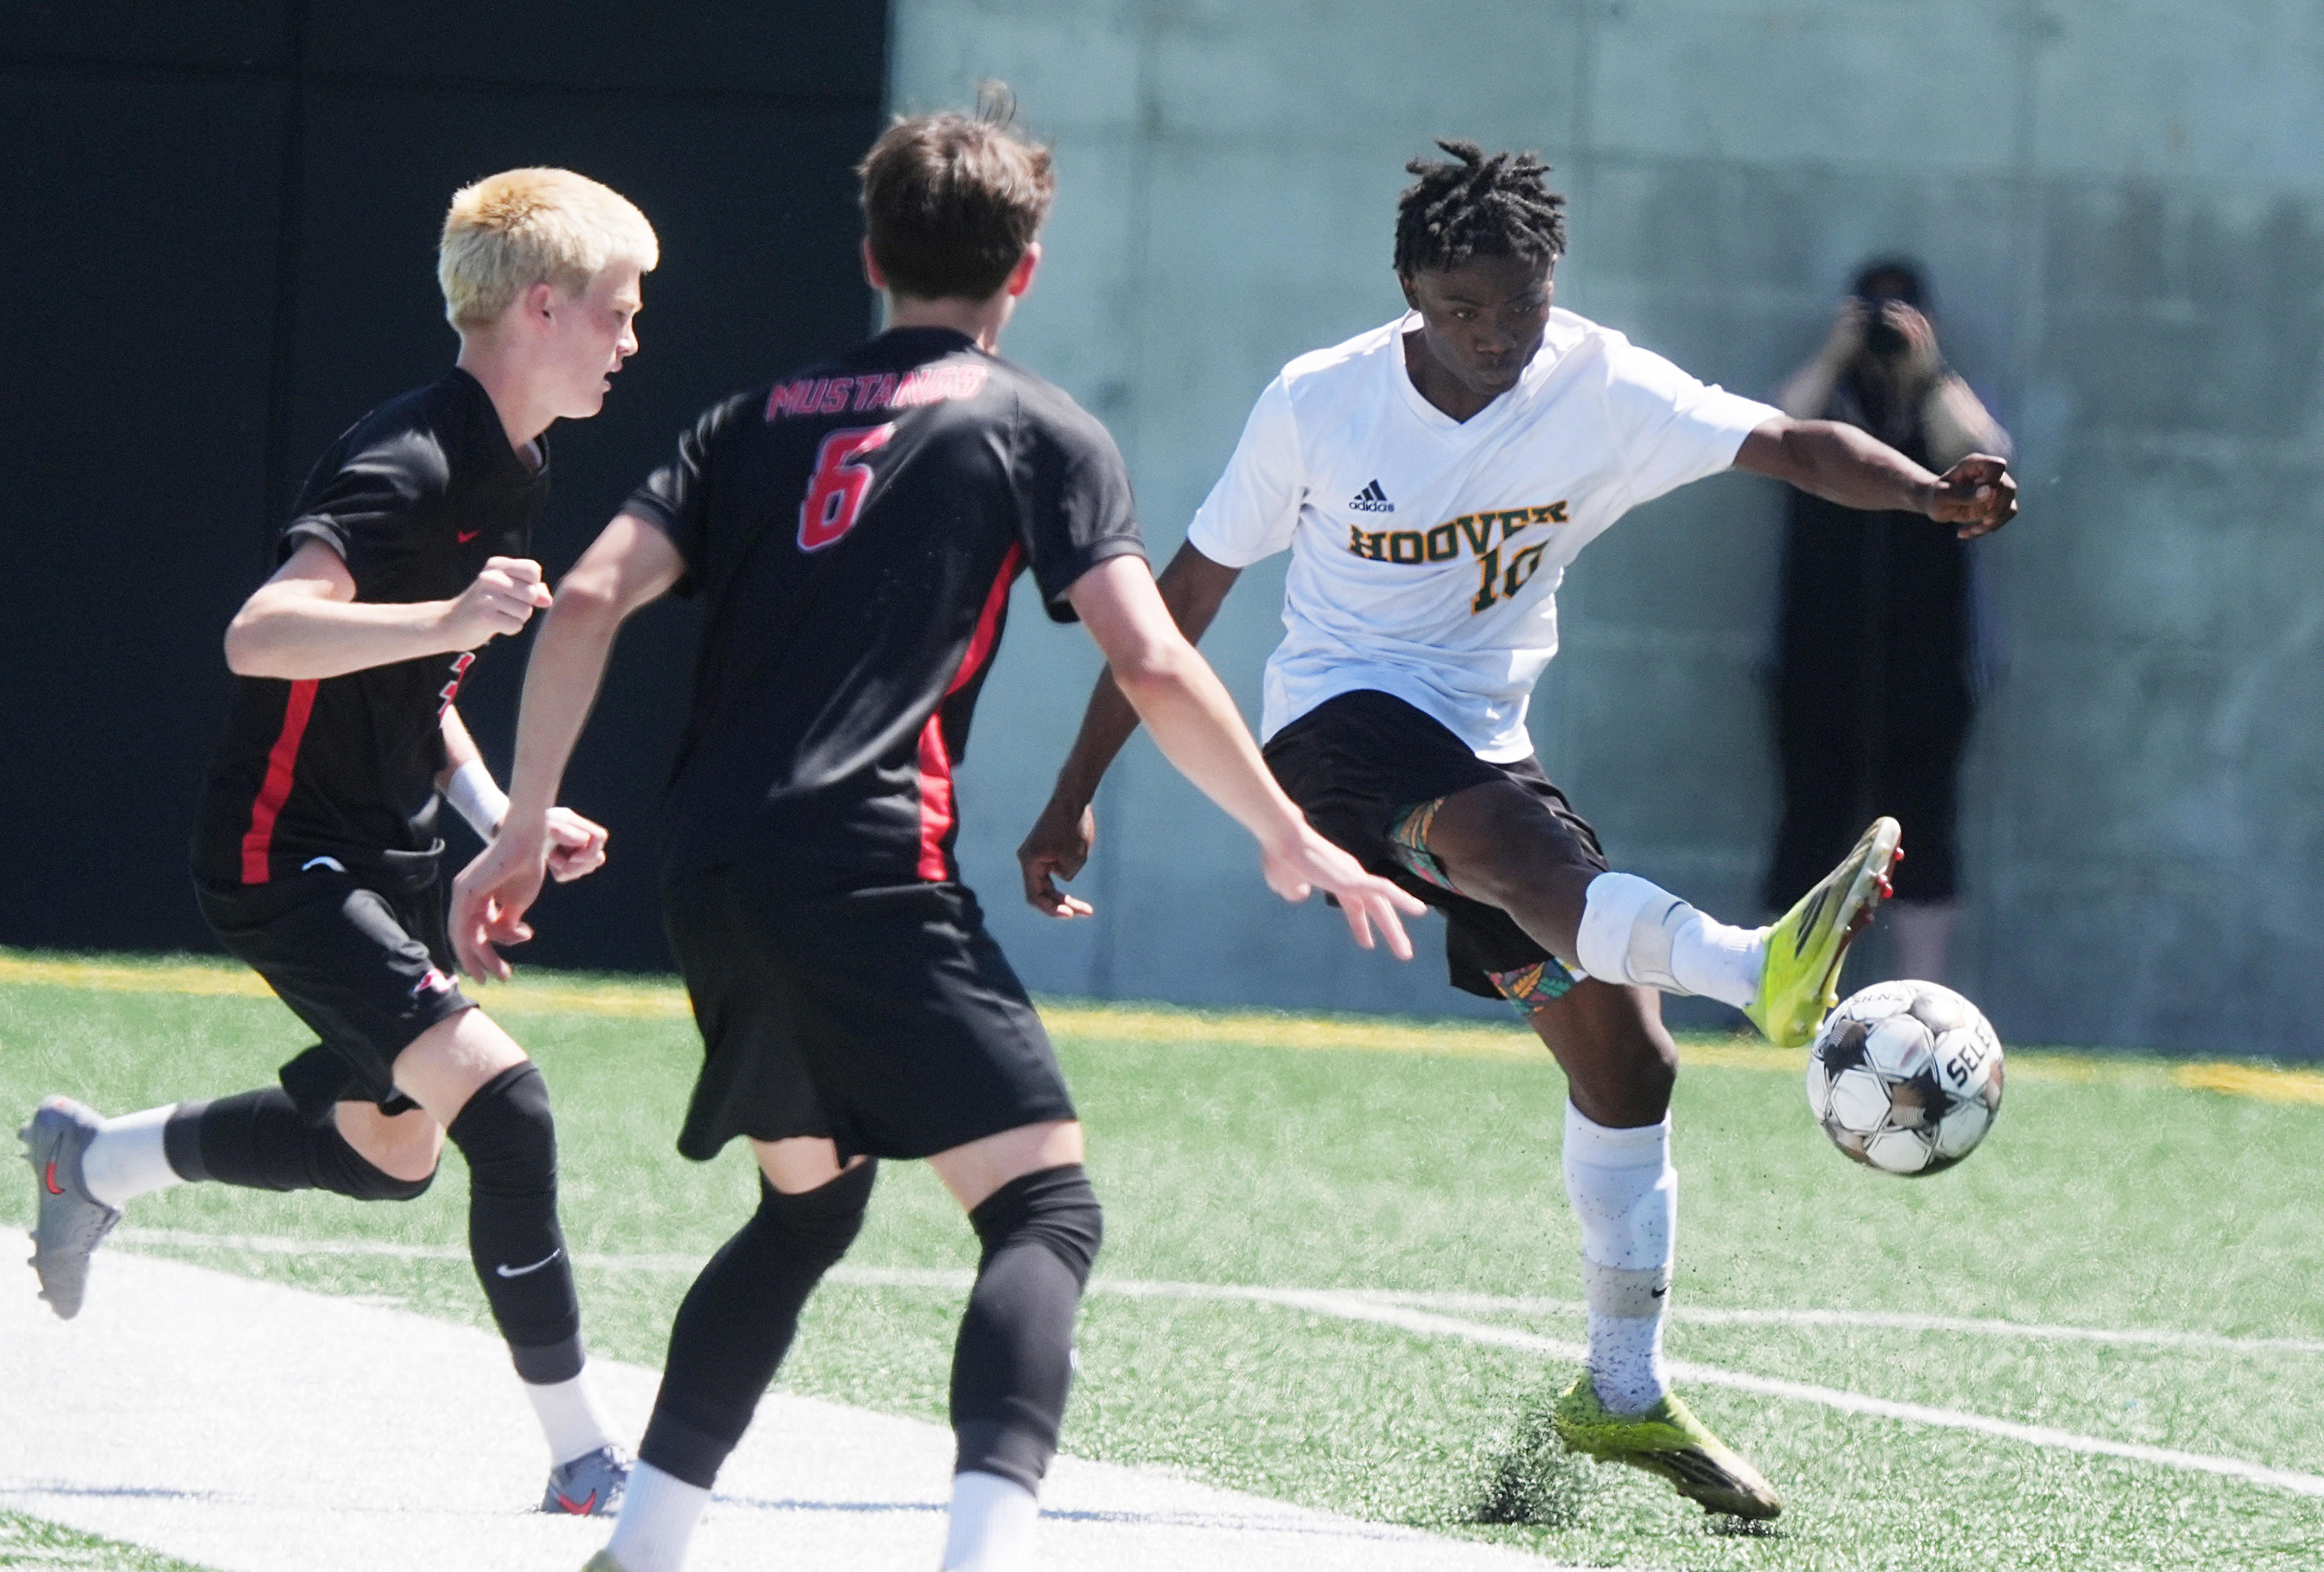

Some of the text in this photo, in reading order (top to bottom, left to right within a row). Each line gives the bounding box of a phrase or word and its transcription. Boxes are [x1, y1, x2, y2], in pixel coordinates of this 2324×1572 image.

[765, 364, 987, 422] MUSTANGS
[797, 421, 897, 551] 6
[1349, 501, 1395, 512] adidas
[1472, 539, 1552, 615] 10
